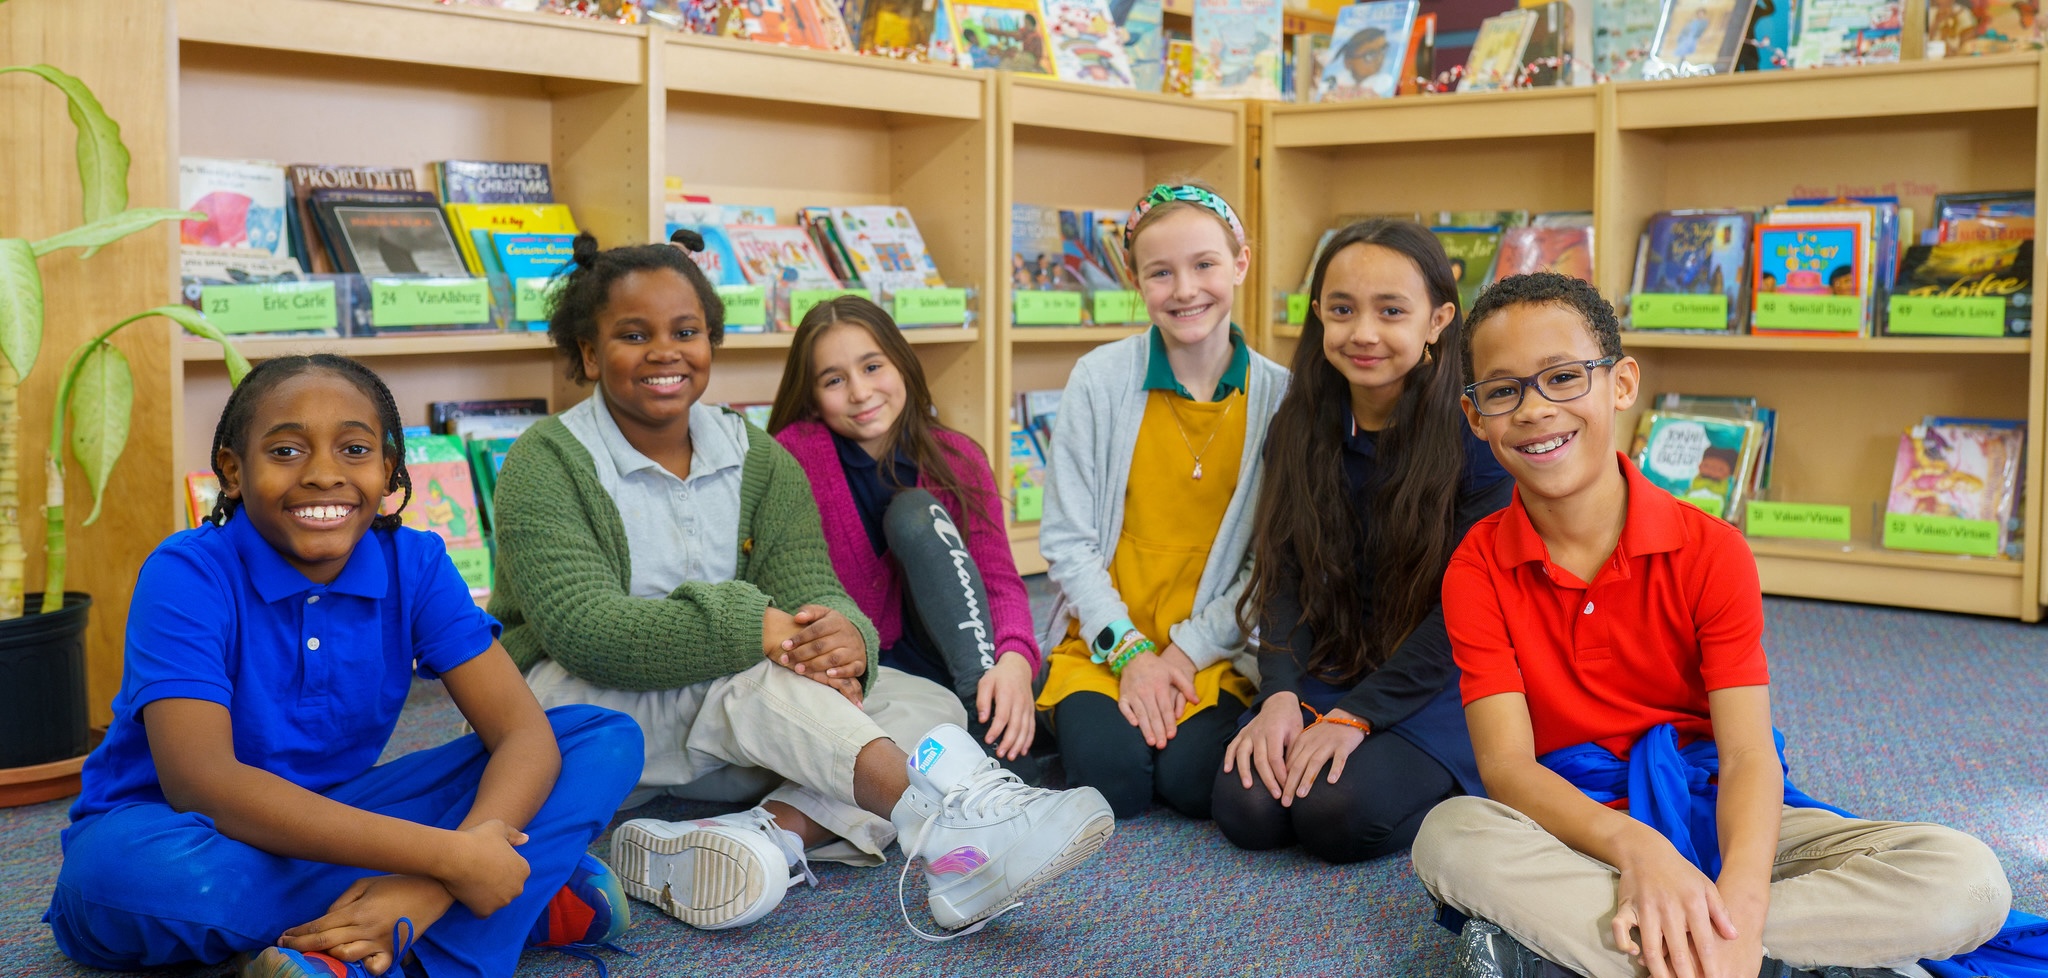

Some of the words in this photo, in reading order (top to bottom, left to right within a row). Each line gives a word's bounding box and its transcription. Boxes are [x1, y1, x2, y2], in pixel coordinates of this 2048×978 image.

[296, 167, 414, 191] PROBUDITI!
[477, 179, 550, 194] CHRISTMAS
[1776, 244, 1839, 259] Birthday
[381, 291, 397, 306] 24
[523, 289, 537, 302] 25
[212, 299, 230, 314] 23
[262, 296, 288, 311] Eric
[292, 293, 327, 309] Carle
[1672, 303, 1720, 313] Christmas
[1789, 303, 1824, 315] Special
[1826, 303, 1853, 316] Days
[1931, 303, 1966, 317] God's
[1969, 305, 1997, 317] Love
[929, 503, 996, 670] Champio
[919, 750, 938, 771] PUMA
